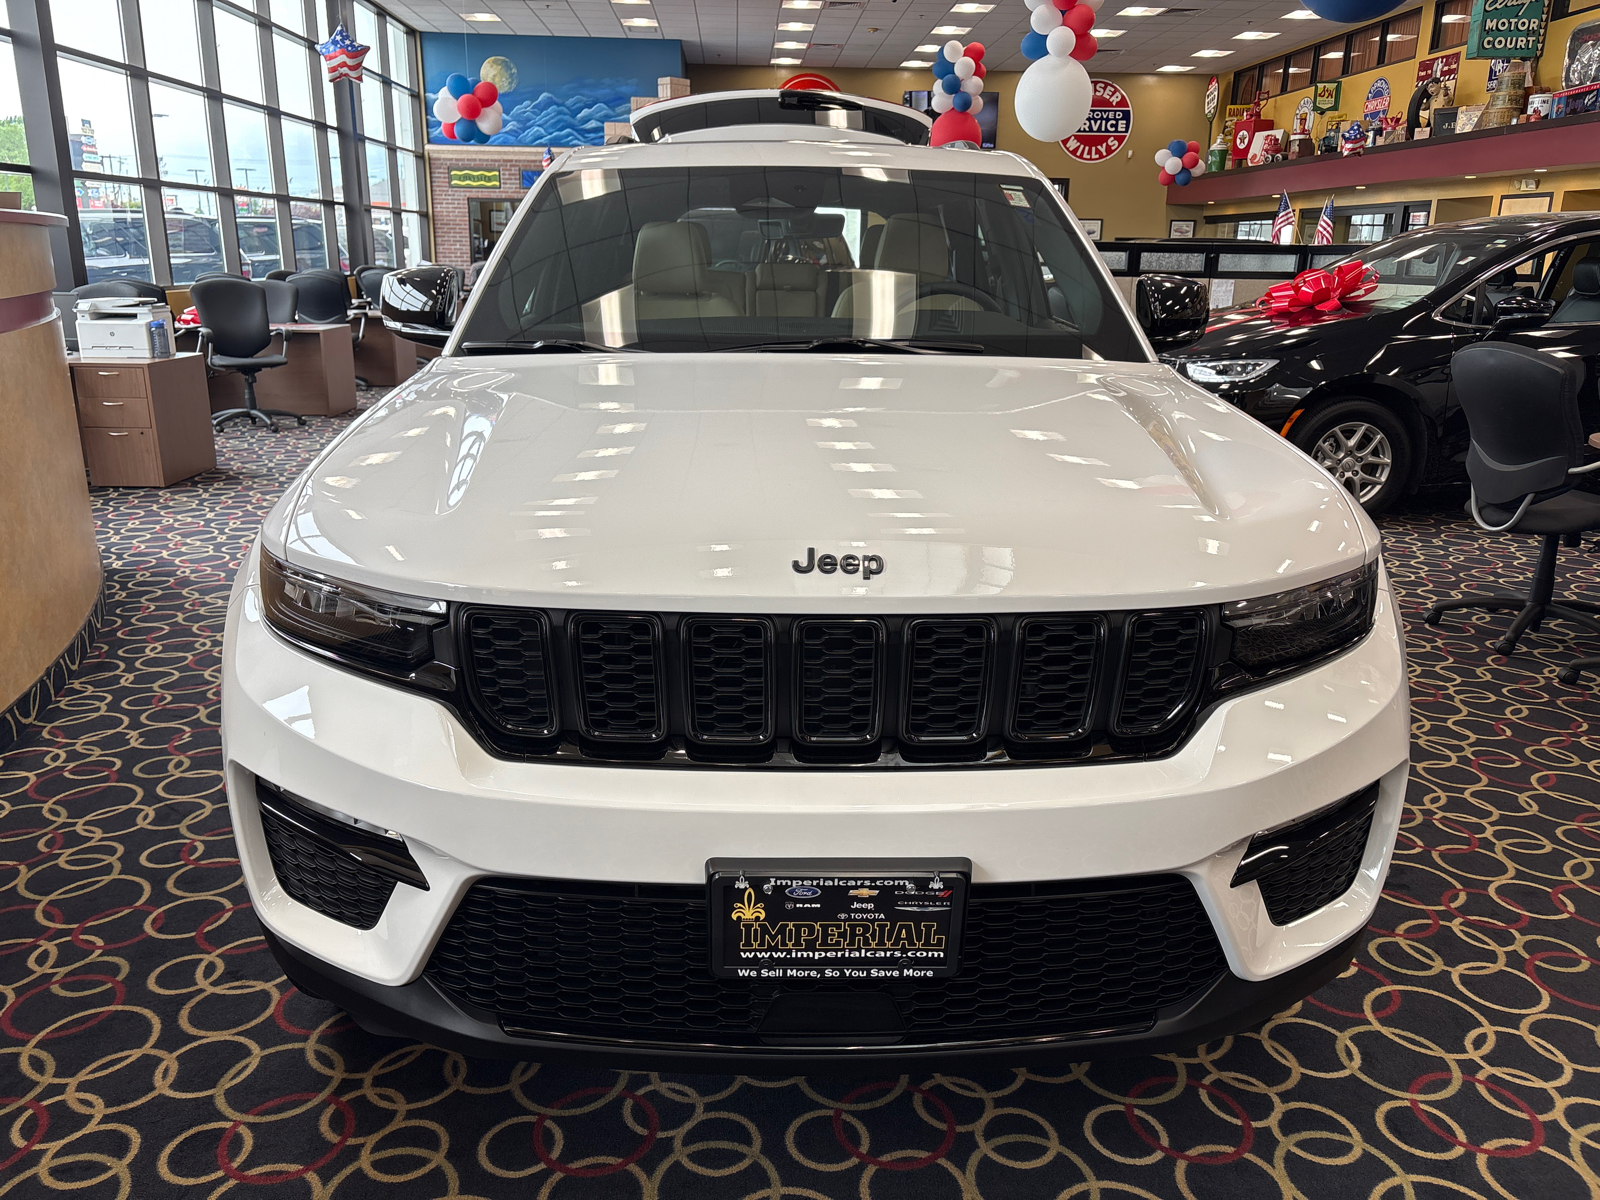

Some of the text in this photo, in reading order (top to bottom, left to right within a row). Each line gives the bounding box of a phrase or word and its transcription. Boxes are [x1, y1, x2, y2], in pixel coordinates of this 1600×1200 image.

[1485, 18, 1539, 31] MOTOR
[1483, 36, 1536, 49] COURT
[1091, 83, 1122, 106] ISER
[1364, 96, 1390, 112] CHRYSLER
[1088, 111, 1123, 119] ROVED
[1080, 120, 1127, 132] RVICE
[1065, 136, 1119, 159] WILLYS
[792, 547, 884, 580] Jeep
[769, 877, 910, 888] Imperialcars.com
[793, 888, 813, 896] Ford
[850, 902, 875, 910] Jeep
[740, 921, 946, 949] IMPERIAL
[740, 949, 945, 960] www.imperialcars.com
[737, 968, 934, 979] We Sell More, So You Save More
